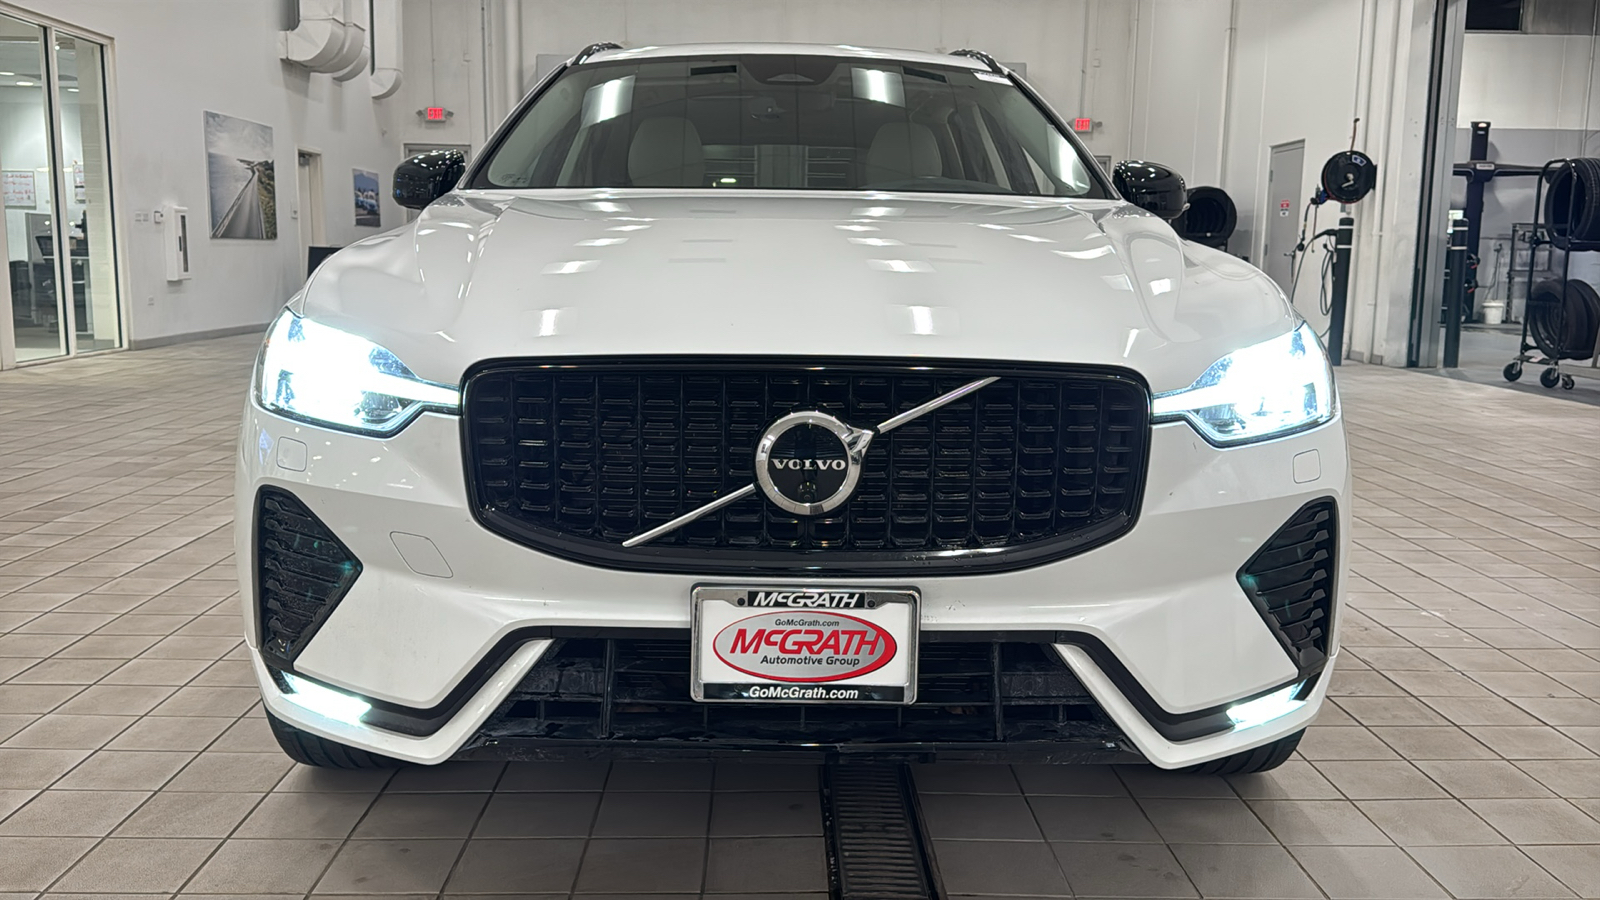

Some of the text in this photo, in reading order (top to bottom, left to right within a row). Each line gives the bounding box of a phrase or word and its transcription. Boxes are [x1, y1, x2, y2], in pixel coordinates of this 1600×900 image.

[428, 107, 443, 120] EXIT
[1075, 118, 1090, 130] EXIT
[771, 458, 846, 471] VOLVO
[774, 618, 840, 627] GoMcGrath.com
[760, 655, 860, 667] Automotive Group
[748, 685, 859, 700] GoMcGrath.com
